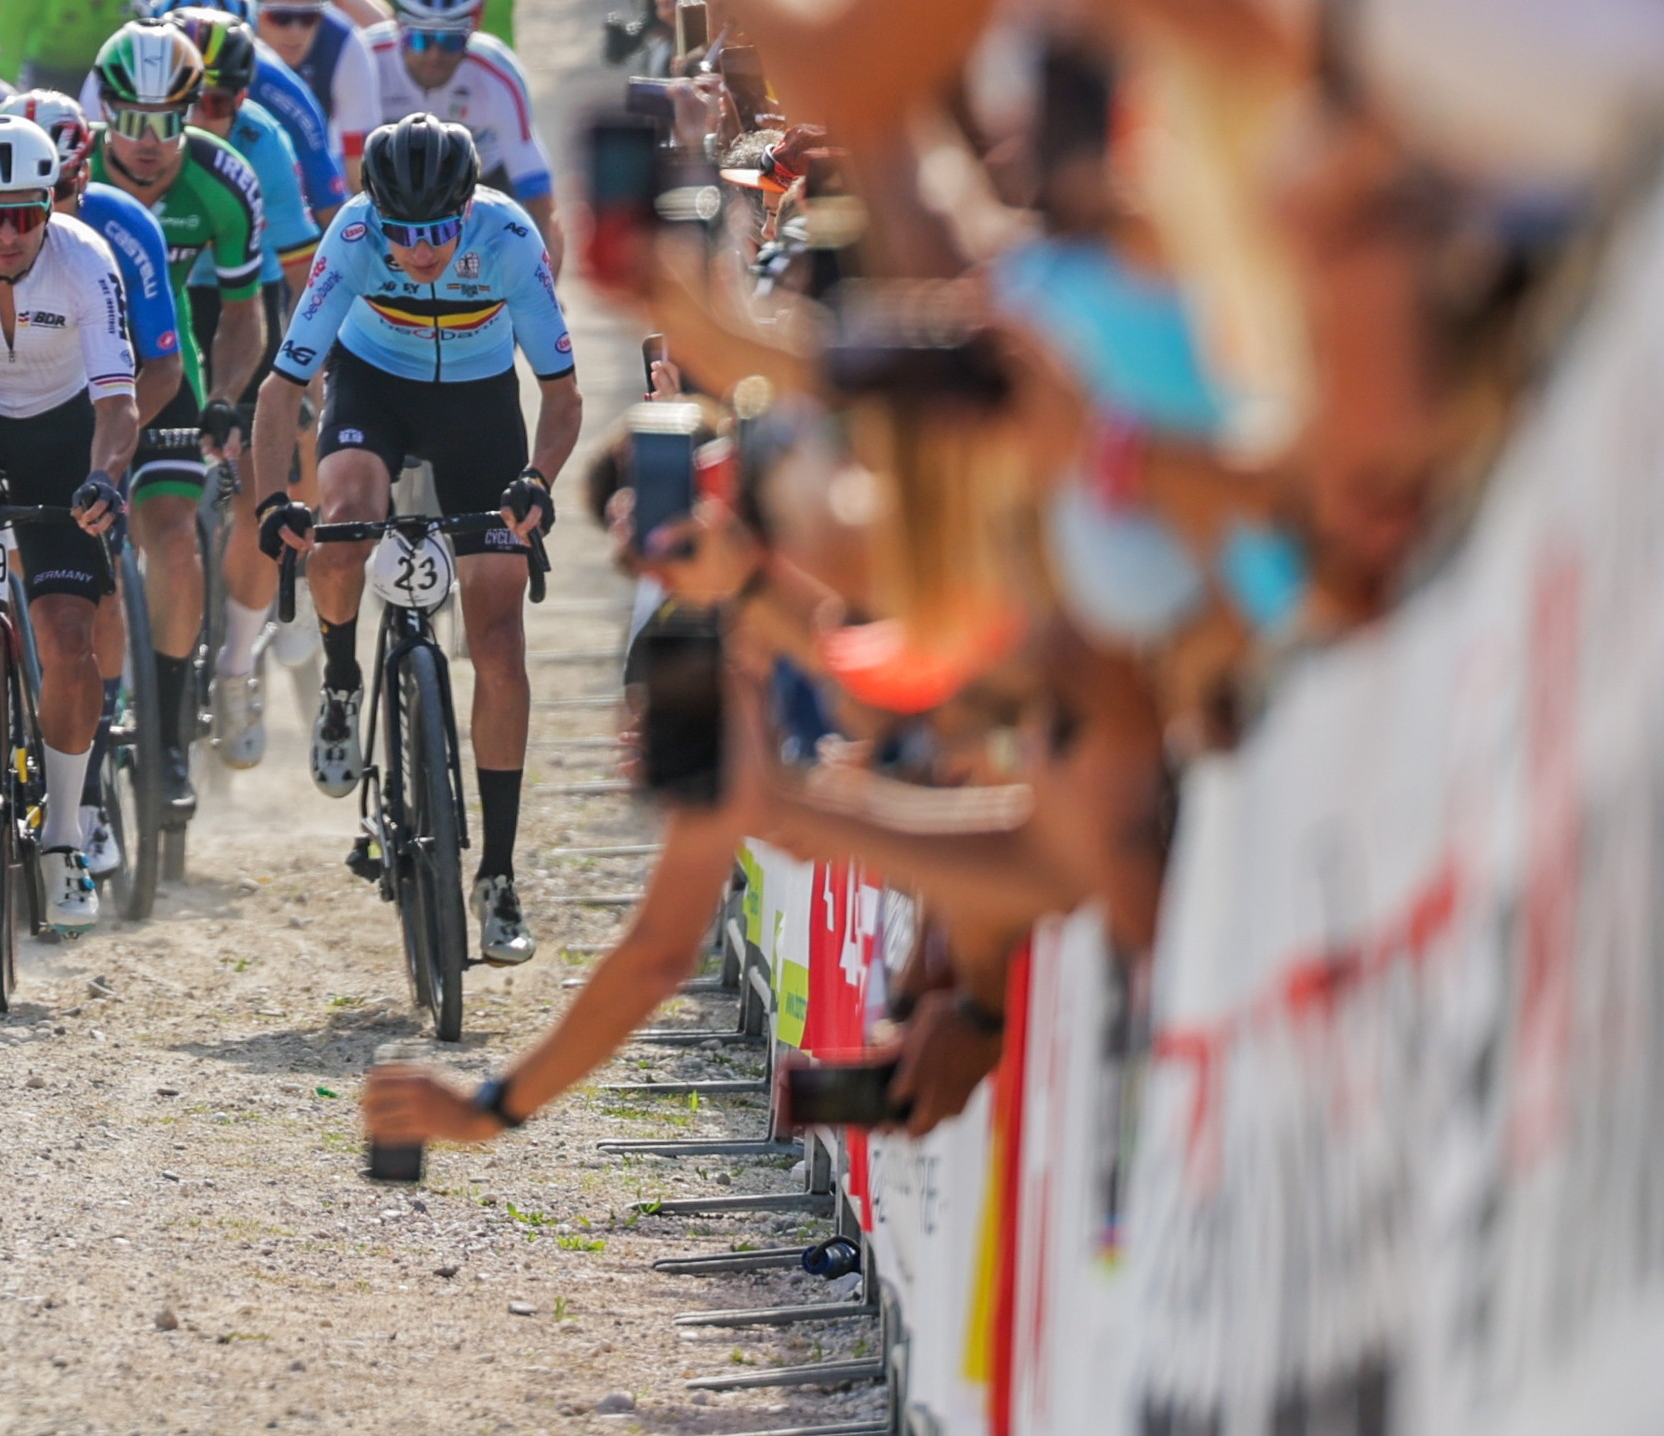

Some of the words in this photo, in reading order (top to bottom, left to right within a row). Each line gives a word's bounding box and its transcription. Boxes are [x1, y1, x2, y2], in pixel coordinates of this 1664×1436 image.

[504, 221, 527, 238] AG
[33, 311, 67, 327] BDR
[280, 340, 317, 365] AG
[484, 531, 523, 545] CYCLIN
[33, 569, 94, 585] GERMANY
[394, 555, 439, 592] 23
